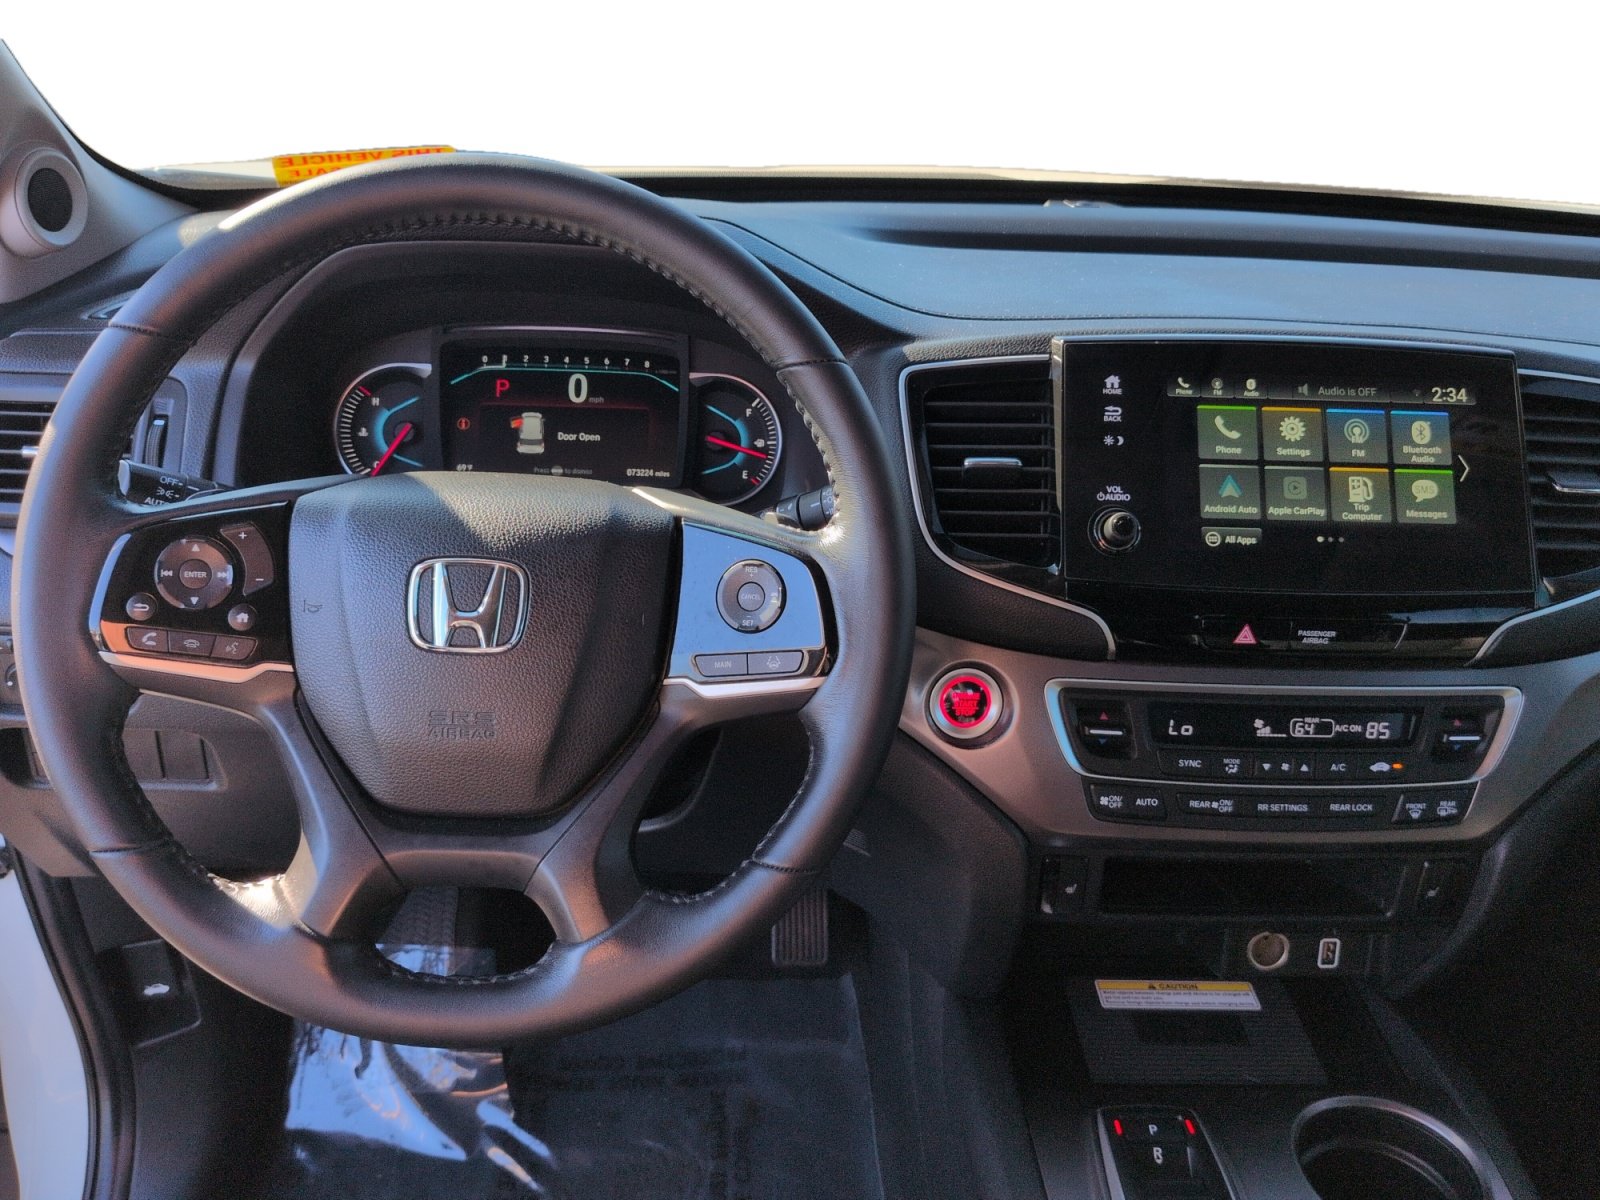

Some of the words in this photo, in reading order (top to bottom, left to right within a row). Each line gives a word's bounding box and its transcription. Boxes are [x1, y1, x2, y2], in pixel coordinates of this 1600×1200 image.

[482, 355, 488, 363] 0
[523, 355, 529, 363] 2
[543, 355, 549, 363] 3
[563, 356, 570, 364] 4
[584, 357, 590, 365] 5
[624, 358, 630, 367] 7
[644, 361, 650, 369] 8
[496, 379, 510, 397] P
[568, 373, 588, 403] 0
[1318, 386, 1344, 396] Audio
[1347, 387, 1356, 396] is
[1358, 387, 1377, 396] OFF
[1431, 387, 1468, 402] 2:34
[746, 408, 752, 417] F
[557, 433, 577, 442] Door
[579, 433, 600, 443] Open
[1215, 446, 1241, 454] Phone
[1276, 447, 1310, 457] Settings
[1351, 449, 1366, 458] FM
[1402, 446, 1442, 455] Bluetooth
[1410, 454, 1435, 464] Audio
[626, 468, 654, 477] 073224
[742, 471, 748, 479] E
[160, 476, 178, 486] OFF
[1414, 484, 1436, 495] SMS
[1105, 493, 1131, 501] AUDIO
[1204, 504, 1235, 514] Android
[1238, 505, 1258, 514] Auto
[1268, 506, 1292, 517] Apple
[1293, 506, 1325, 517] CarPlay
[1353, 503, 1370, 513] Trip
[1342, 512, 1382, 522] Computer
[1406, 510, 1447, 520] Messages
[1225, 535, 1235, 544] All
[1237, 535, 1256, 547] Apps
[429, 711, 496, 725] SRS
[1294, 723, 1315, 735] 64
[1335, 724, 1348, 732] A/C
[1350, 724, 1362, 732] ON
[1365, 722, 1390, 739] 85
[428, 728, 496, 739] AIRBAG
[1178, 759, 1202, 768] SYNC
[1330, 763, 1346, 772] A/C
[1135, 798, 1158, 806] AUTO
[1189, 800, 1210, 808] REAR
[1257, 803, 1269, 812] RR
[1270, 803, 1308, 813] SETTINGS
[1330, 803, 1350, 812] REAR
[1351, 803, 1373, 812] LOCK
[1148, 1124, 1158, 1136] P
